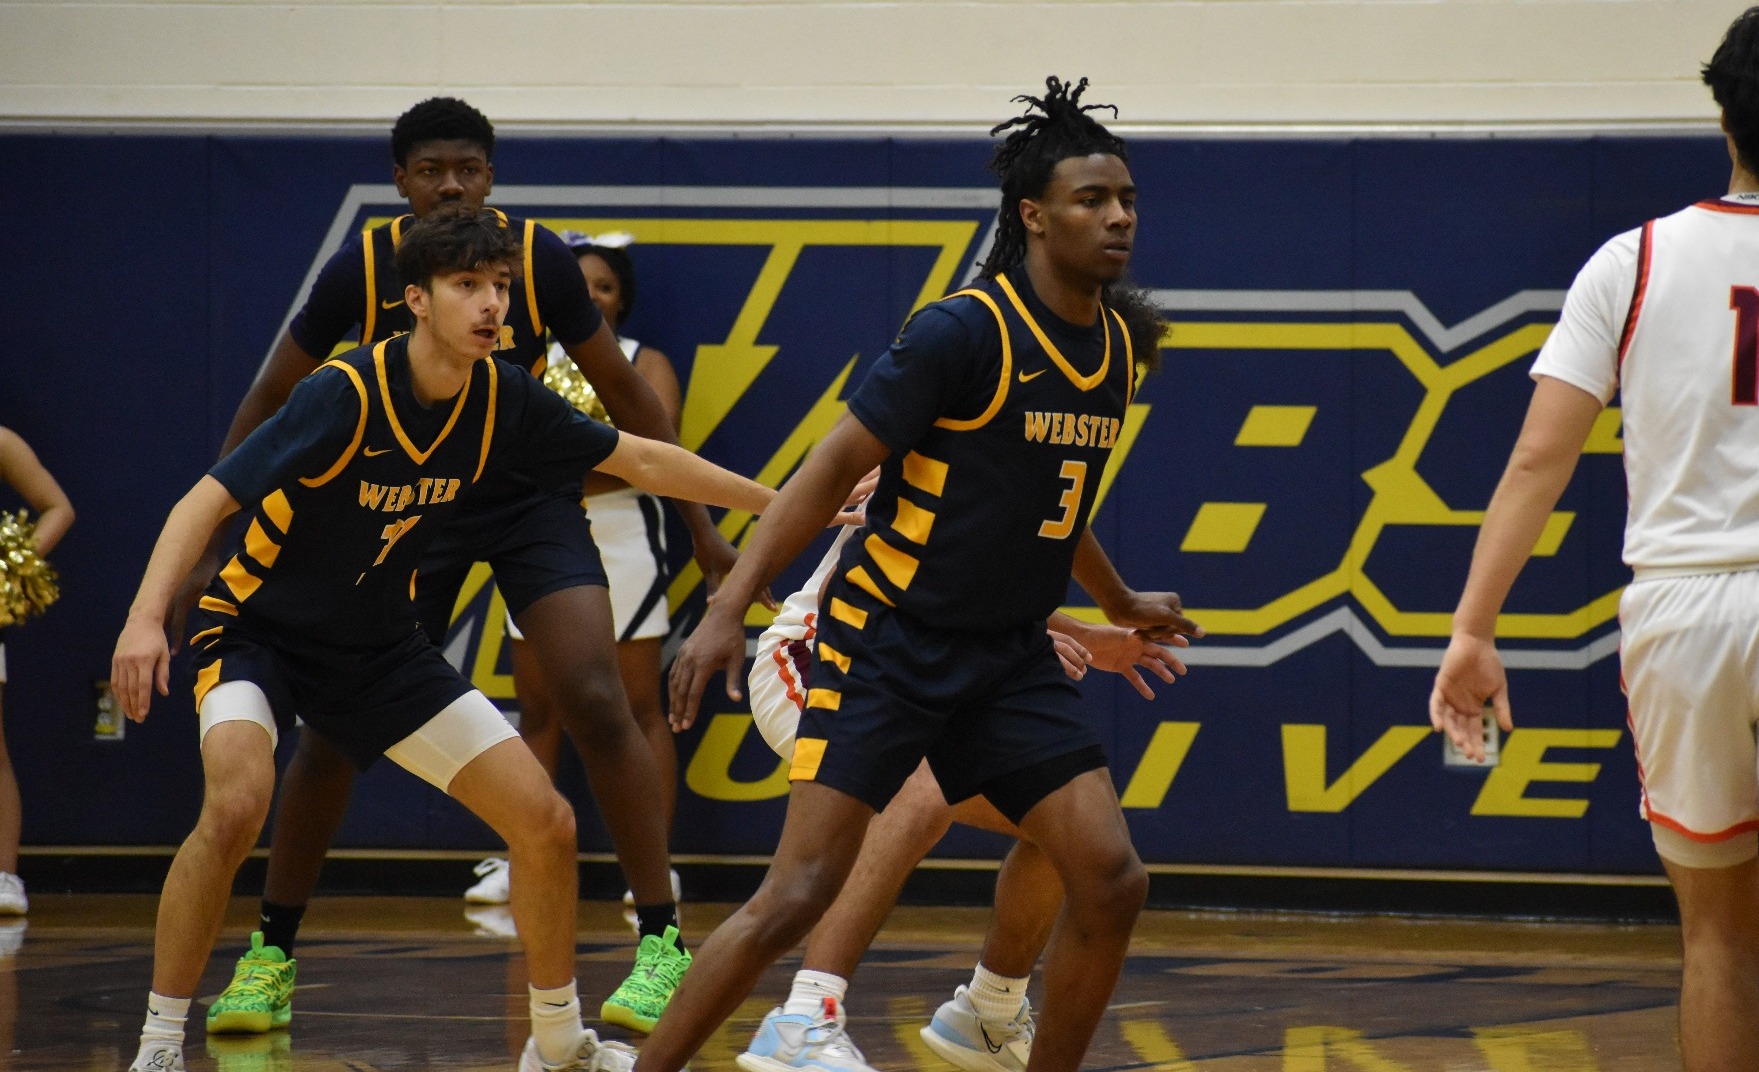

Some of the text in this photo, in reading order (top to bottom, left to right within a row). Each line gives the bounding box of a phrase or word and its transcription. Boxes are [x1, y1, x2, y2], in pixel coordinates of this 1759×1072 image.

[1024, 411, 1120, 449] WEBSTER
[358, 477, 461, 512] WEBTER
[1037, 459, 1088, 540] 3
